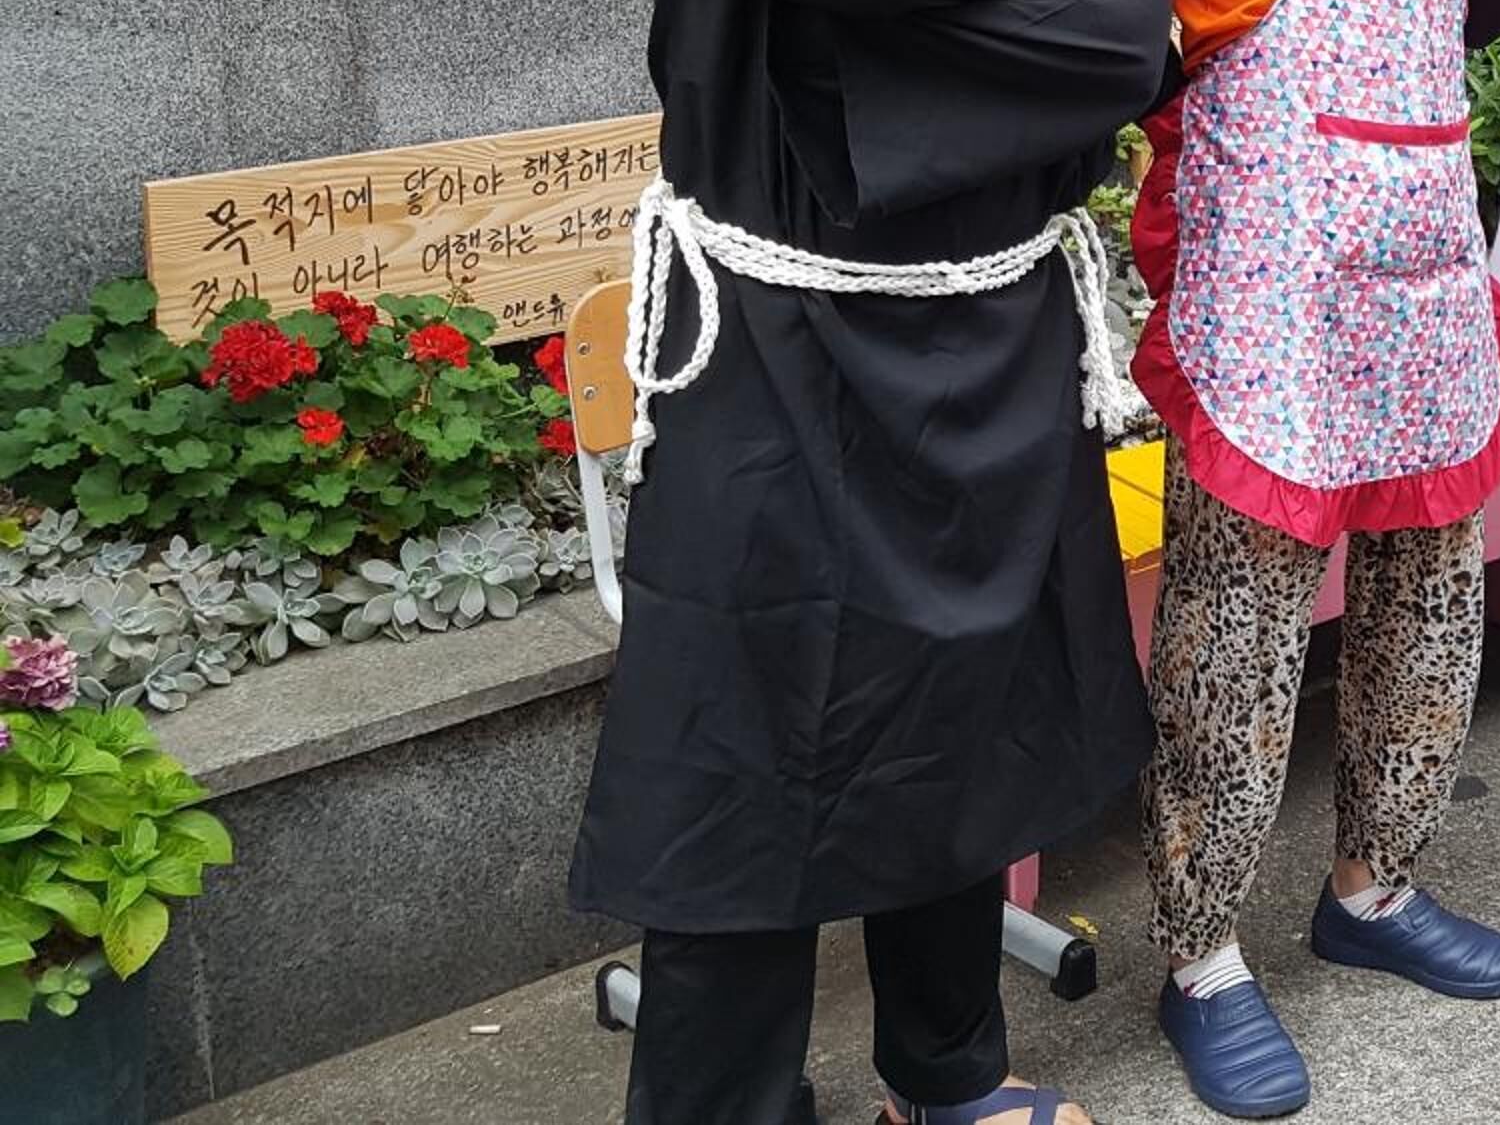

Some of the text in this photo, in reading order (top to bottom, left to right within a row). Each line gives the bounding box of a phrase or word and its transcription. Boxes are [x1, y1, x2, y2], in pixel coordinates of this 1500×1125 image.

[203, 176, 374, 265] 목적지에
[522, 143, 660, 196] 행복해지는
[293, 245, 389, 298] 아니라
[422, 224, 538, 280] 여행하는
